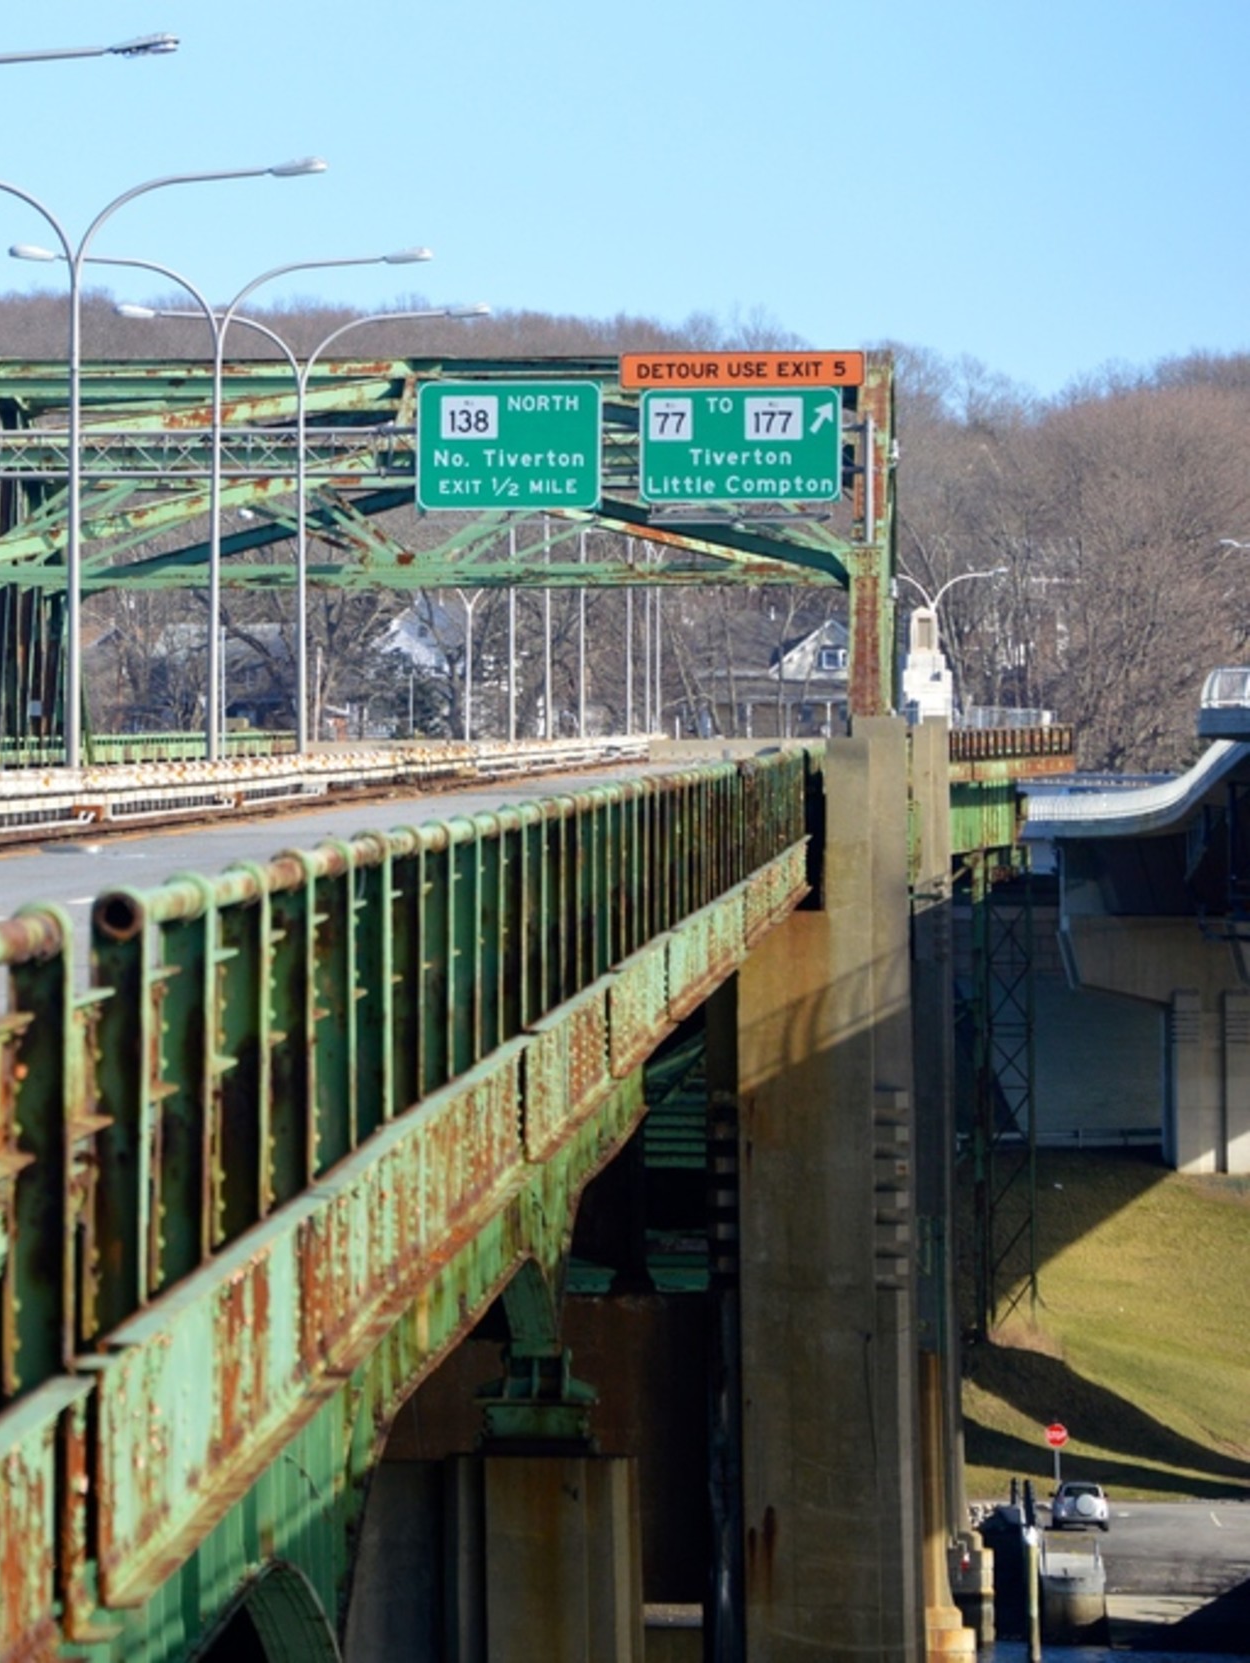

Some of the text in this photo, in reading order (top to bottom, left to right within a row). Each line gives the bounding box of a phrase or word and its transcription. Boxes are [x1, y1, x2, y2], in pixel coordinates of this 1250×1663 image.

[637, 361, 846, 379] DETOUR USE EXIT 5
[507, 395, 579, 411] NORTH
[706, 397, 733, 413] TO
[449, 409, 489, 433] 138
[654, 411, 686, 434] 77
[753, 411, 792, 434] 177
[433, 449, 584, 467] No. Tiverton
[689, 448, 792, 466] Tiverton
[439, 479, 482, 494] EXIT
[529, 479, 578, 494] MILE
[648, 475, 833, 496] Little Compton
